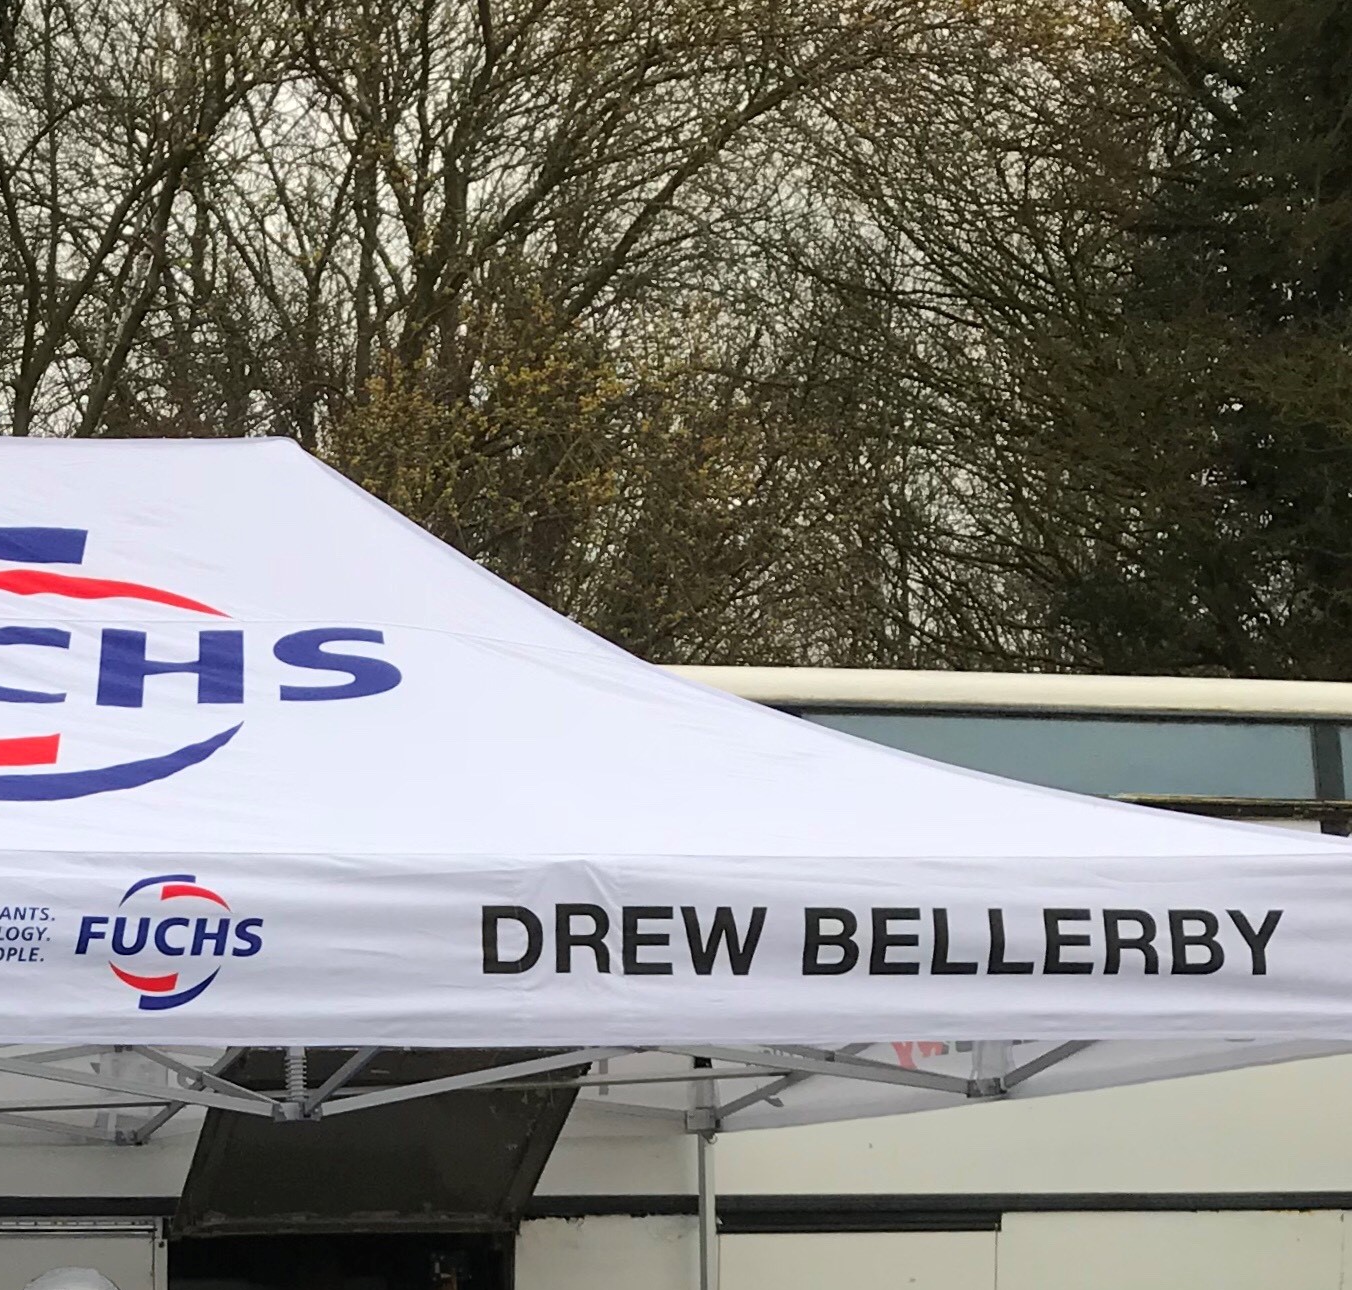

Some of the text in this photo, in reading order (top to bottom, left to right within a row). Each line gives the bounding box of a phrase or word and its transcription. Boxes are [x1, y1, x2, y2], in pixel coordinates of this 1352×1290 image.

[74, 916, 263, 957] FUCHS
[482, 904, 1283, 976] DREW BELLERBY
